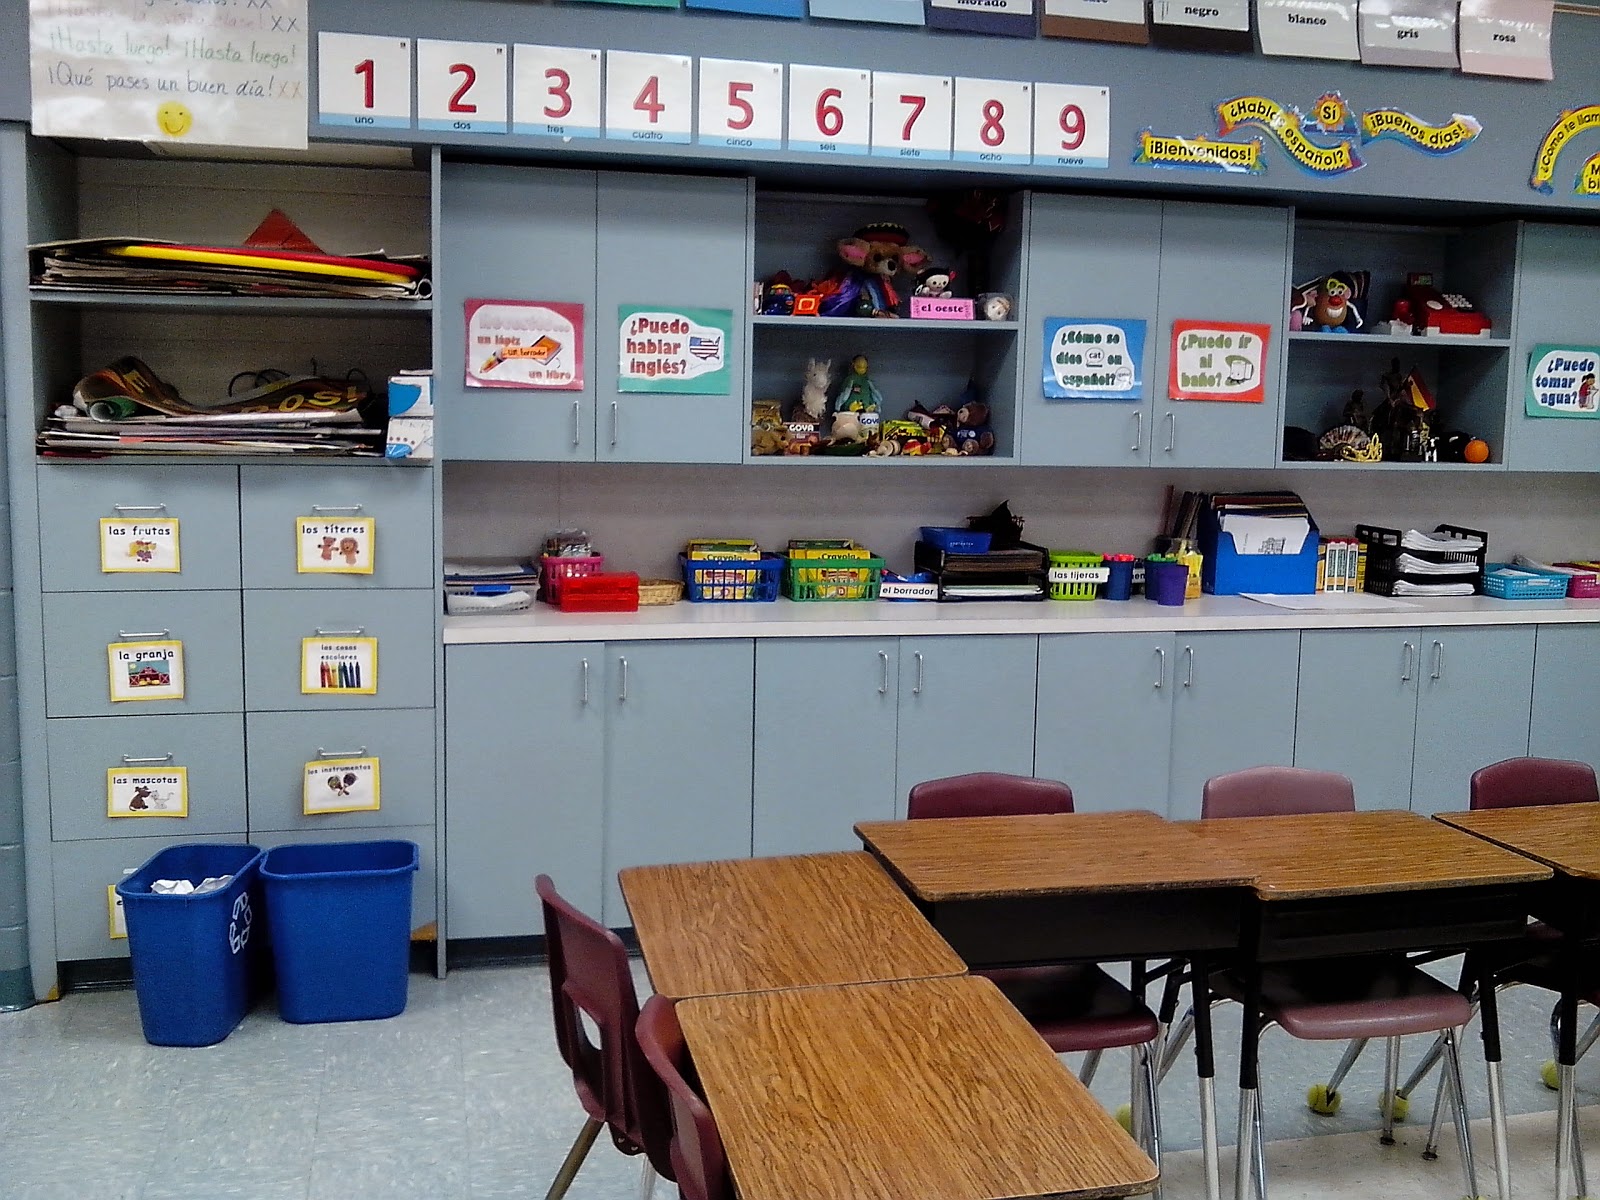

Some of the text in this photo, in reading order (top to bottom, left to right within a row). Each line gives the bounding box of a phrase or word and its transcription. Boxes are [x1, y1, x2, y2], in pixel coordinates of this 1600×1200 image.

[1184, 5, 1219, 20] negro
[1288, 14, 1327, 26] blanco
[1397, 28, 1419, 40] gris
[1493, 32, 1516, 43] rosa
[126, 32, 170, 64] luego!
[185, 39, 242, 62] ¡Hasta
[250, 40, 296, 68] luego!
[48, 61, 93, 86] ¡Qué
[106, 74, 150, 95] pases
[157, 78, 179, 92] un
[187, 70, 228, 95] buen
[236, 76, 274, 98] día!
[354, 58, 374, 109] 1
[448, 63, 477, 113] 2
[543, 68, 572, 118] 3
[633, 75, 665, 123] 4
[727, 81, 754, 130] 5
[815, 87, 844, 136] 6
[900, 95, 926, 141] 7
[1323, 104, 1337, 119] Sí
[354, 116, 374, 125] uno
[453, 121, 471, 130] dos
[980, 99, 1006, 146] 8
[1058, 103, 1086, 150] 9
[1370, 114, 1425, 140] ¡Buenos
[1564, 121, 1576, 132] te
[547, 124, 564, 134] tres
[632, 130, 663, 140] cuatro
[726, 137, 753, 147] cinco
[820, 142, 836, 151] seis
[1285, 128, 1344, 166] español?
[900, 148, 920, 157] siete
[980, 152, 1002, 161] ocho
[1150, 141, 1251, 161] ¡Bienvenidos!
[1057, 157, 1084, 165] nueve
[921, 304, 965, 314] el oeste
[630, 317, 690, 336] ¿Puedo
[1061, 331, 1120, 345] ¿Cómo se
[1181, 334, 1252, 351] ¿Puedo ir
[626, 338, 681, 355] hablar
[1056, 351, 1082, 365] dice
[1107, 355, 1122, 365] en
[1200, 353, 1212, 368] al
[629, 358, 687, 377] inglés?
[1548, 358, 1595, 373] ¿Puedo
[546, 369, 571, 380] libro
[1062, 373, 1116, 387] español?
[1181, 372, 1222, 387] baño?
[1535, 375, 1576, 388] tomar
[1541, 391, 1577, 406] agua?
[109, 525, 171, 536] las frutas
[302, 523, 365, 534] los títeres
[1054, 571, 1100, 581] las tijeras
[893, 586, 934, 595] borrador
[119, 649, 174, 661] la granja
[321, 764, 371, 773] instrumentos
[132, 776, 178, 784] mascotas
